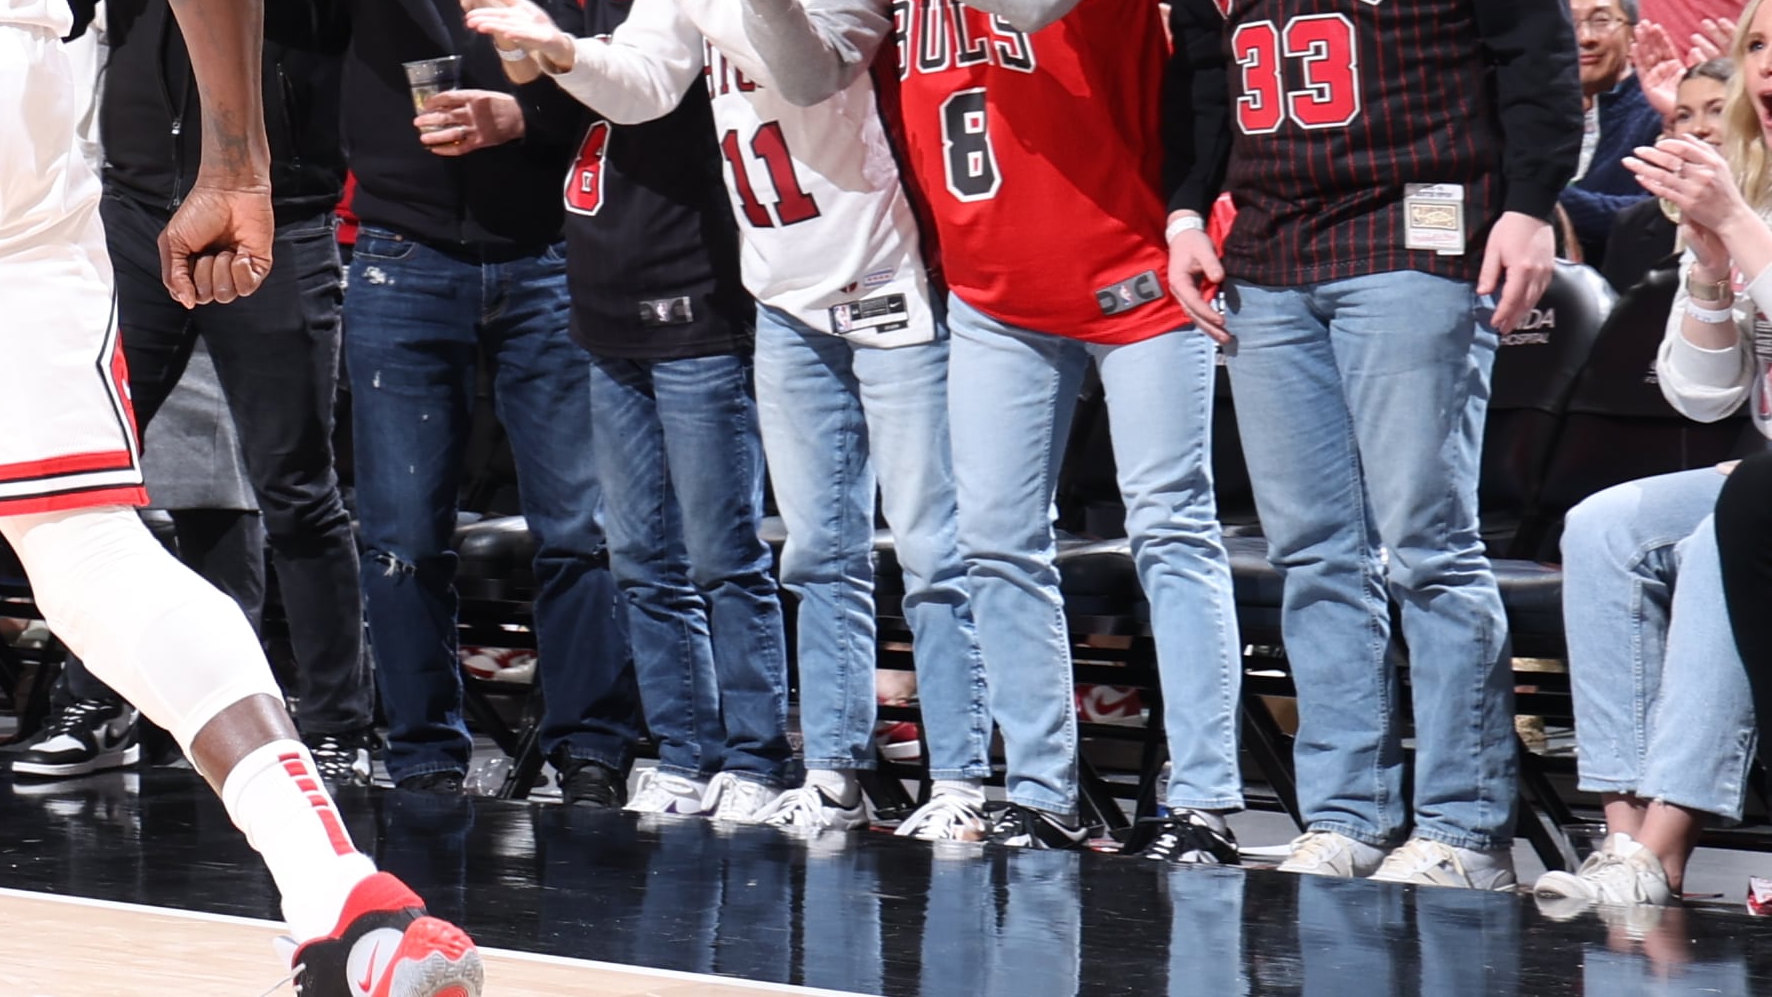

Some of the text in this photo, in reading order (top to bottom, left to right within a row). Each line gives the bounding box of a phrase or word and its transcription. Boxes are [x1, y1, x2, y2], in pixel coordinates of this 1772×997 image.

[1231, 12, 1360, 135] 33
[720, 120, 822, 229] 11
[939, 86, 1003, 203] 8
